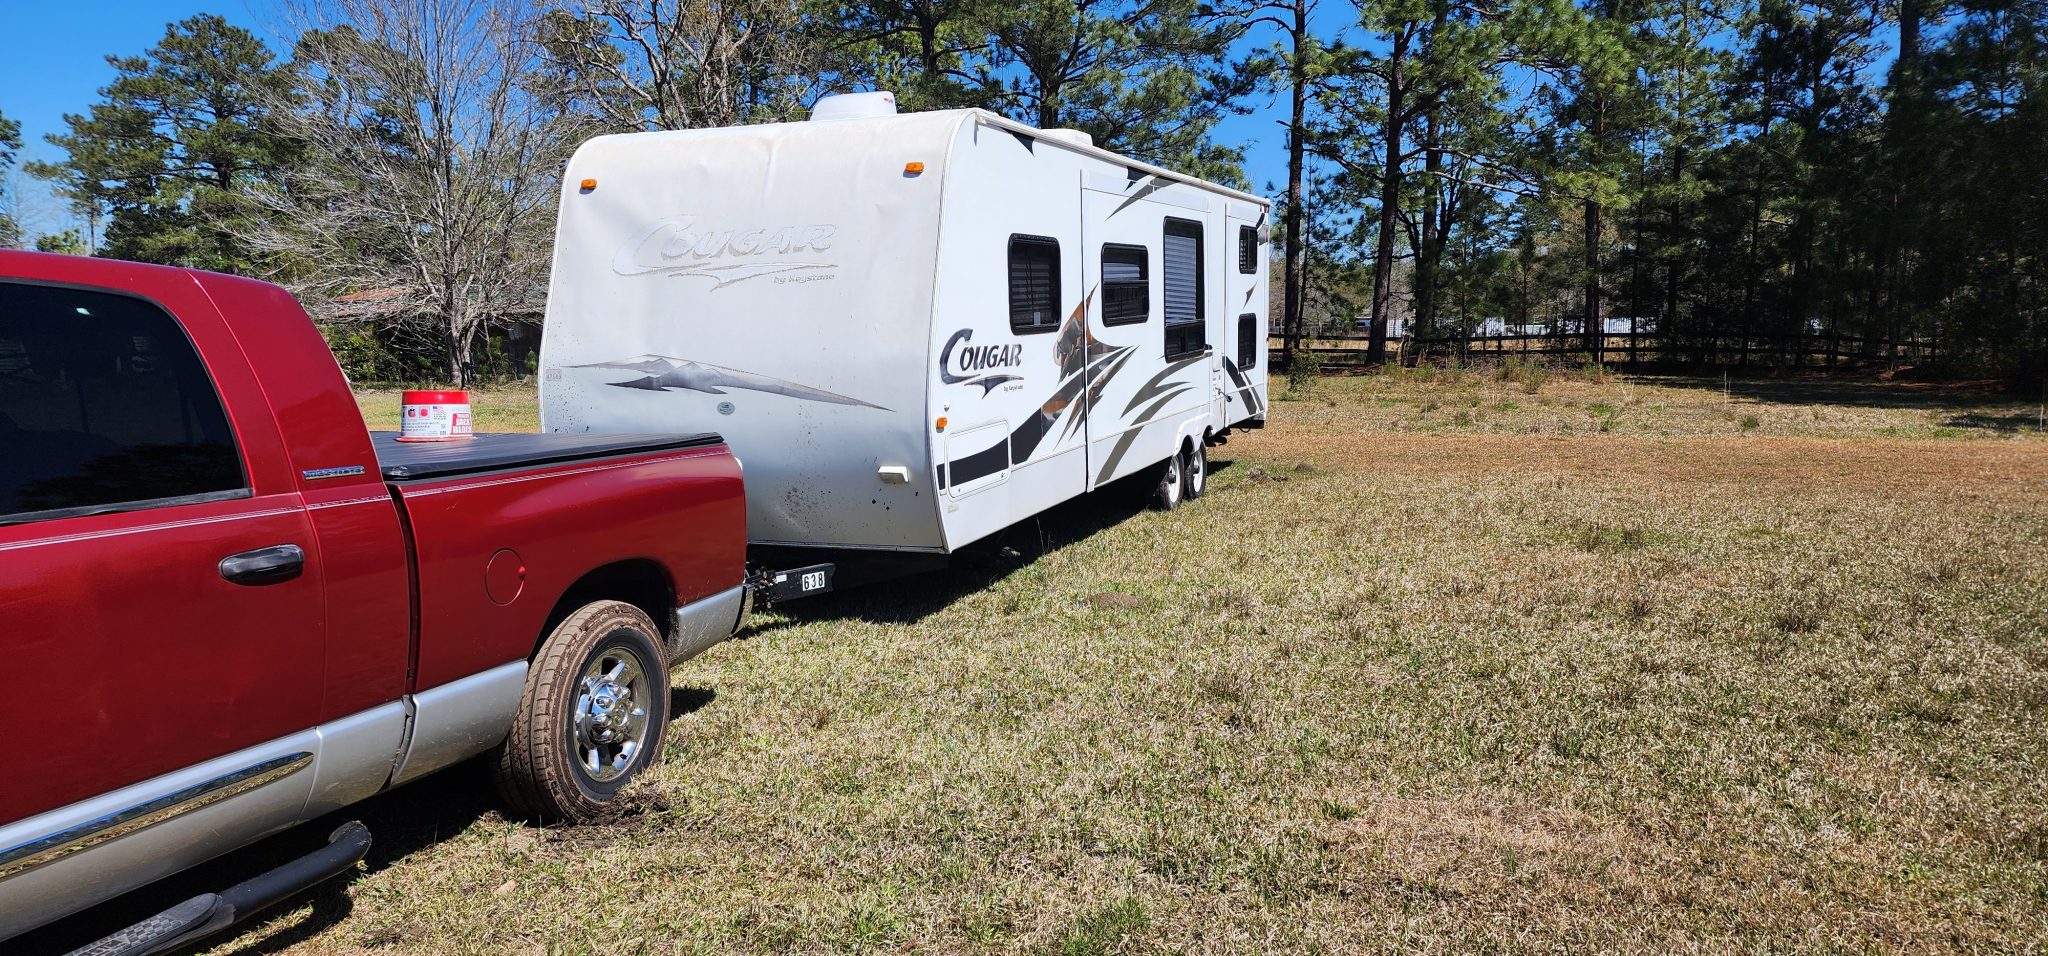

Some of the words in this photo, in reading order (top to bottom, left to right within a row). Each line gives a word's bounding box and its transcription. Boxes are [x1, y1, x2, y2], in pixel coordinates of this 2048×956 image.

[612, 214, 837, 276] COUGAR
[940, 328, 1022, 384] COUGAR
[804, 573, 823, 589] 638
